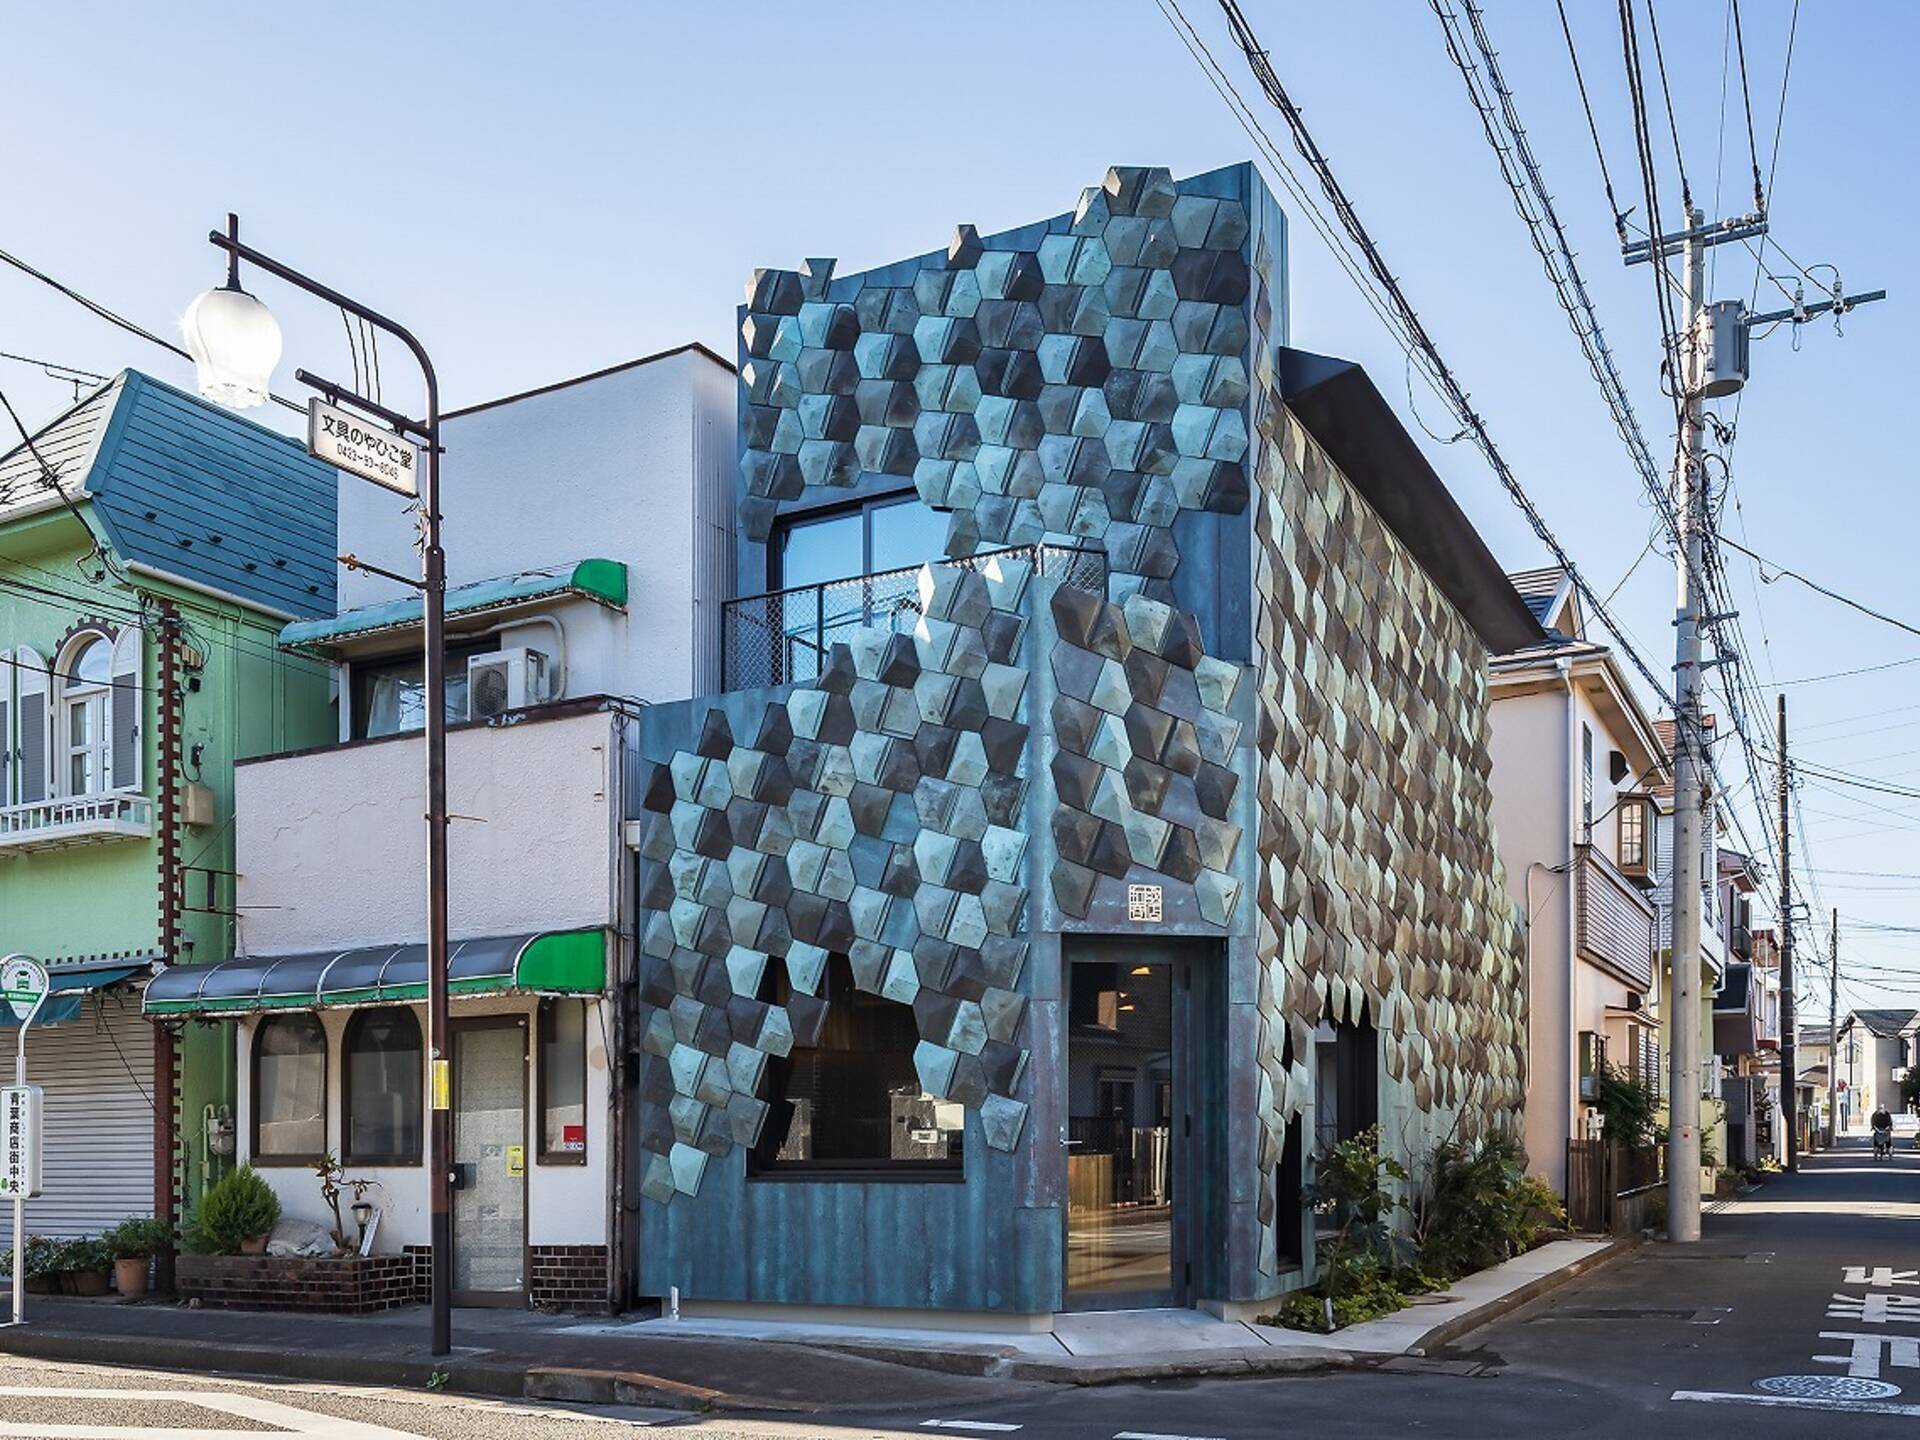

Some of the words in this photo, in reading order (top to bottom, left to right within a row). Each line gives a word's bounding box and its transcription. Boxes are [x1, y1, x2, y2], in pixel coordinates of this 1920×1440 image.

[322, 414, 412, 470] 文具のやひこ堂
[9, 1092, 20, 1193] 青葉商店街中央
